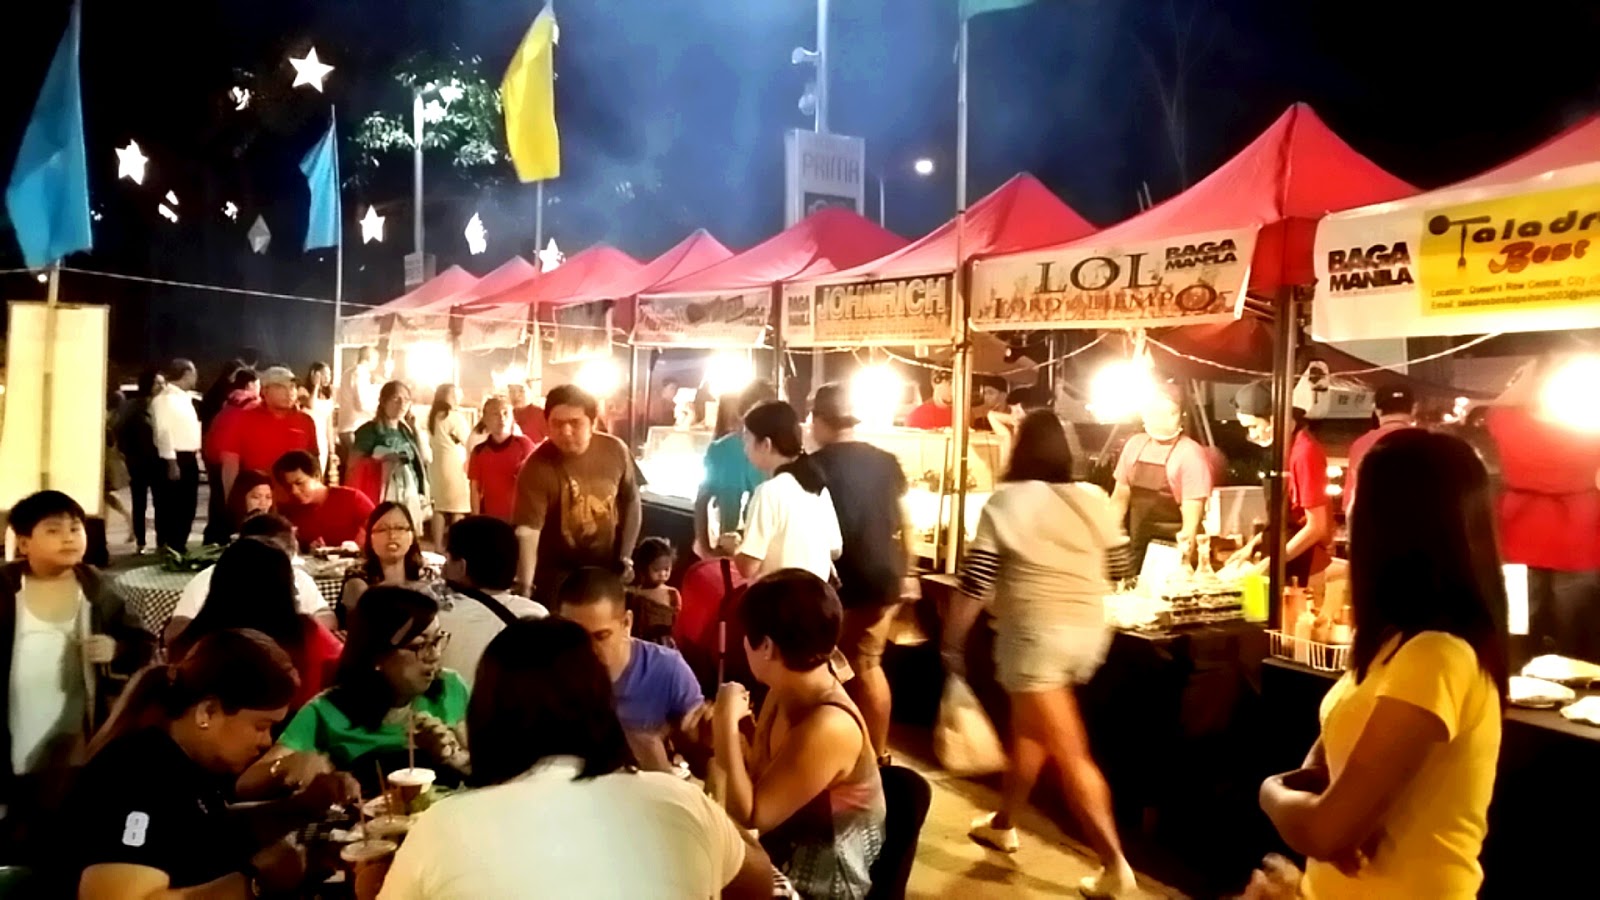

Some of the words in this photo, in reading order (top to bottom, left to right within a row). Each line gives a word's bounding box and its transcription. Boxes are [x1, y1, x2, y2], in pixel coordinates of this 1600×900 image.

[802, 152, 860, 185] PRIMA
[1164, 252, 1238, 272] MANILA
[1165, 238, 1237, 260] BAGA
[1328, 242, 1411, 274] BAGA
[1488, 239, 1591, 274] Best
[1036, 252, 1163, 294] LOL
[1329, 267, 1414, 292] MANILA
[1505, 281, 1525, 290] Row
[1567, 275, 1586, 287] City
[817, 276, 946, 321] JOHNRICH
[122, 811, 150, 847] 8
